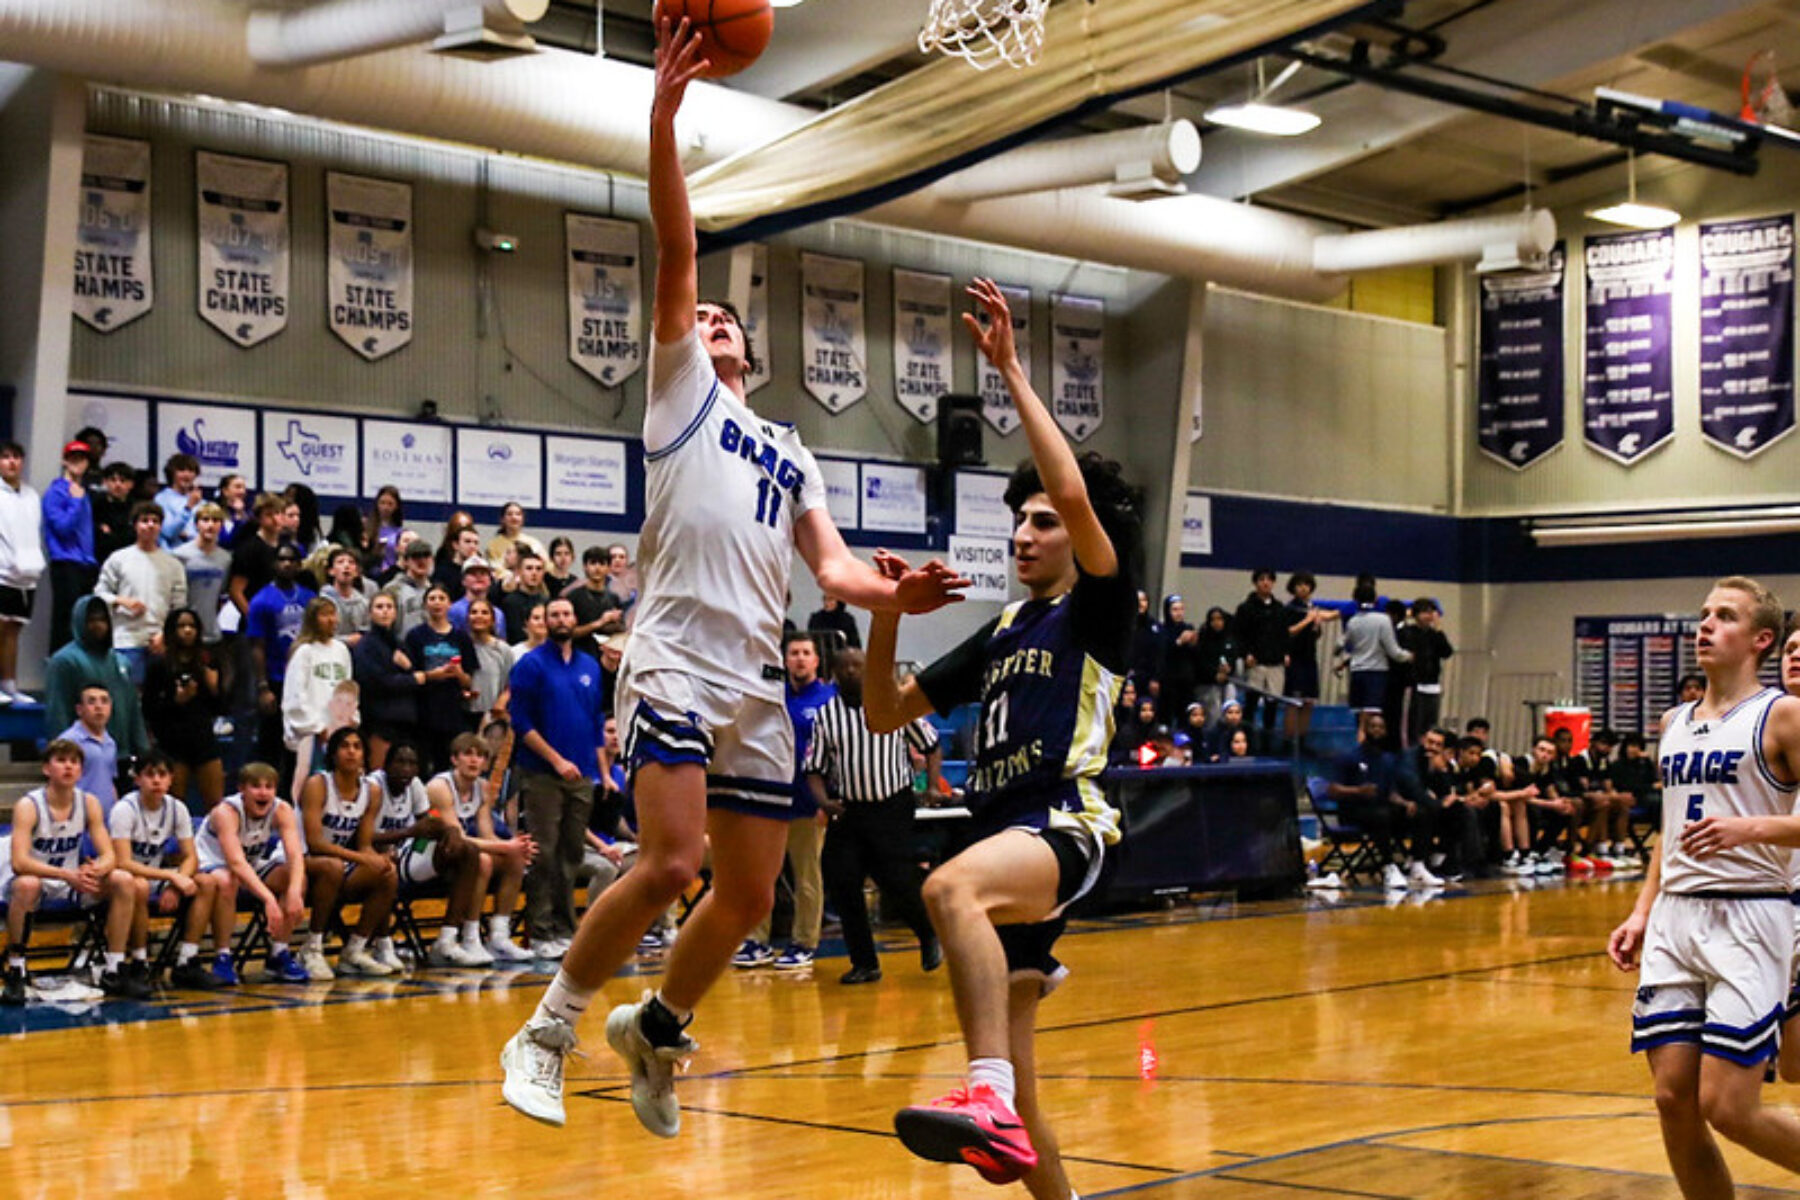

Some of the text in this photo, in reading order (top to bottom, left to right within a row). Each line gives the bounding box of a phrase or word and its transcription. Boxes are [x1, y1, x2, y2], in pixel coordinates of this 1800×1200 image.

[1587, 237, 1673, 266] COUGARS
[1701, 224, 1792, 256] COUGARS
[75, 251, 133, 276] STATE
[215, 268, 272, 294] STATE
[207, 288, 285, 316] CHAMPS
[345, 284, 396, 309] STATE
[334, 304, 409, 330] CHAMPS
[582, 317, 630, 339] STATE
[578, 337, 639, 360] CHAMPS
[816, 349, 851, 369] STATE
[807, 365, 862, 388] CHAMPS
[907, 361, 942, 381] STATE
[899, 377, 948, 398] CHAMPS
[1063, 382, 1097, 400] STATE
[301, 443, 344, 459] GUEST
[755, 477, 783, 528] 11
[953, 546, 1005, 564] VISITOR
[1661, 749, 1745, 788] GRACE
[1686, 794, 1705, 822] 5
